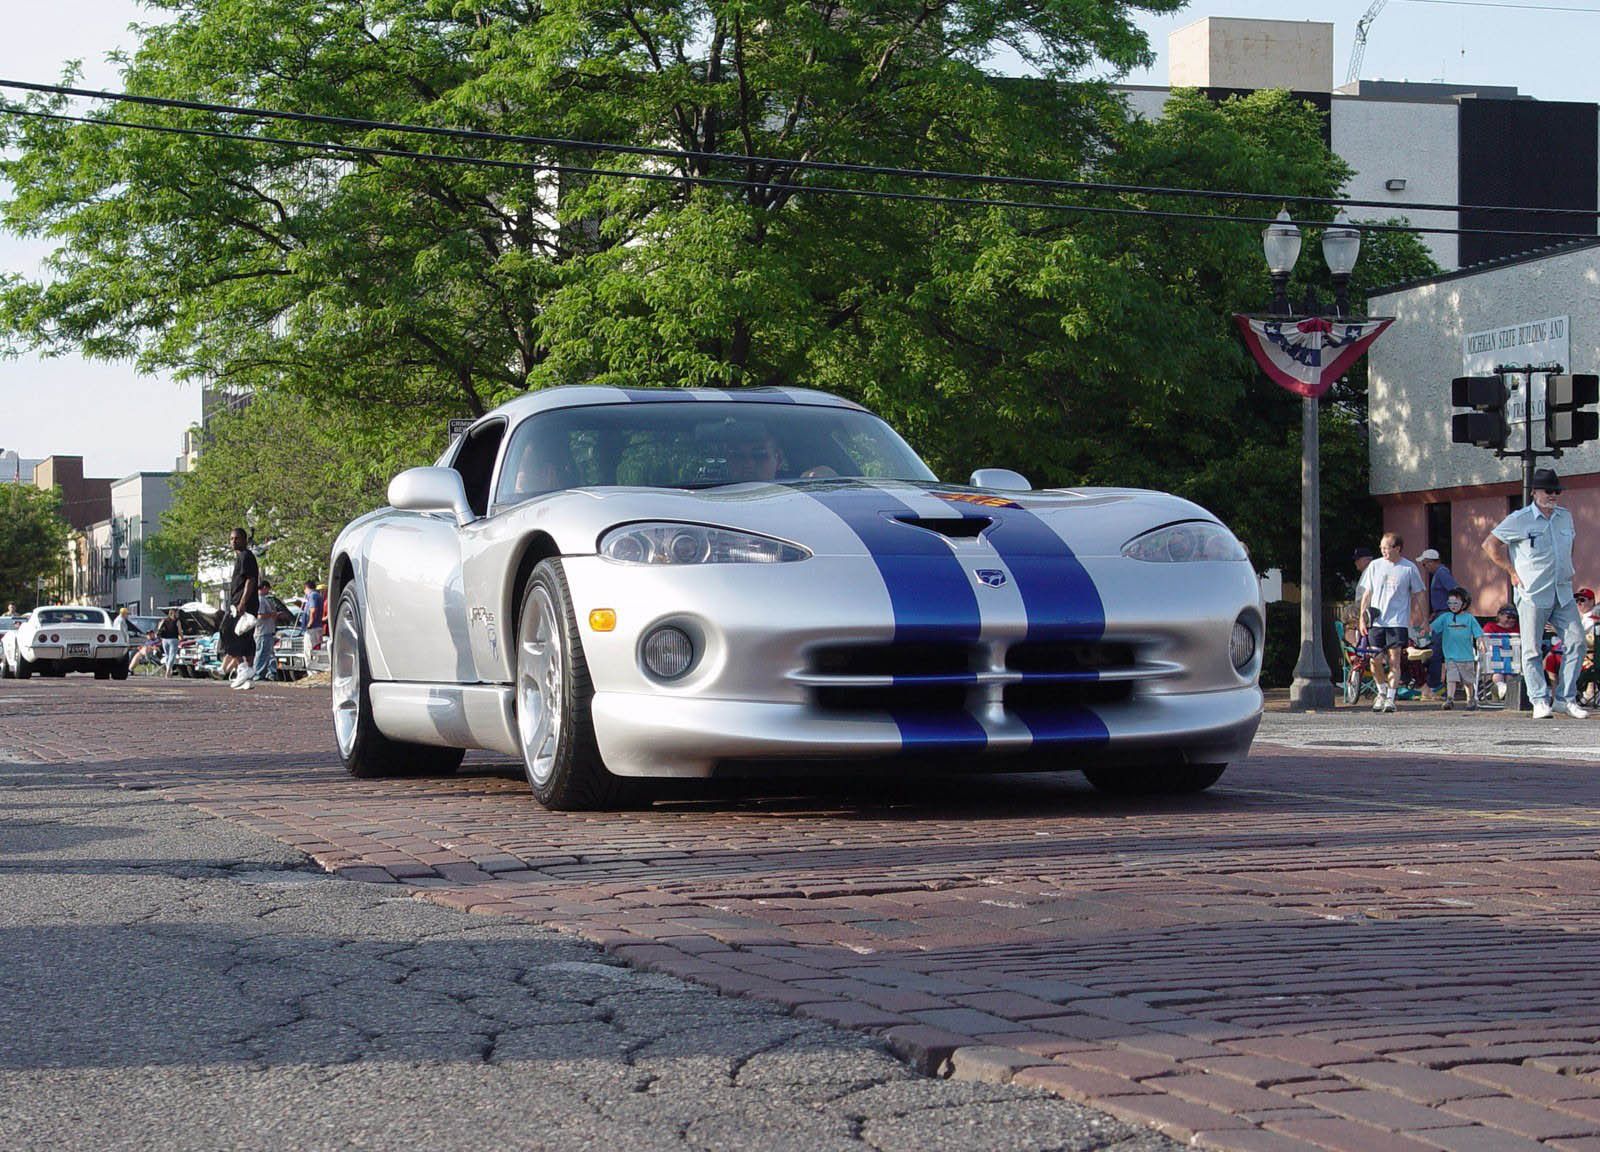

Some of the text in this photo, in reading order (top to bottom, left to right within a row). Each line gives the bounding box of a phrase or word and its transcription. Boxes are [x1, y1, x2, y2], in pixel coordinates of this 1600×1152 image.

[1467, 319, 1564, 354] MICHIGAN STATE BUILDING AND
